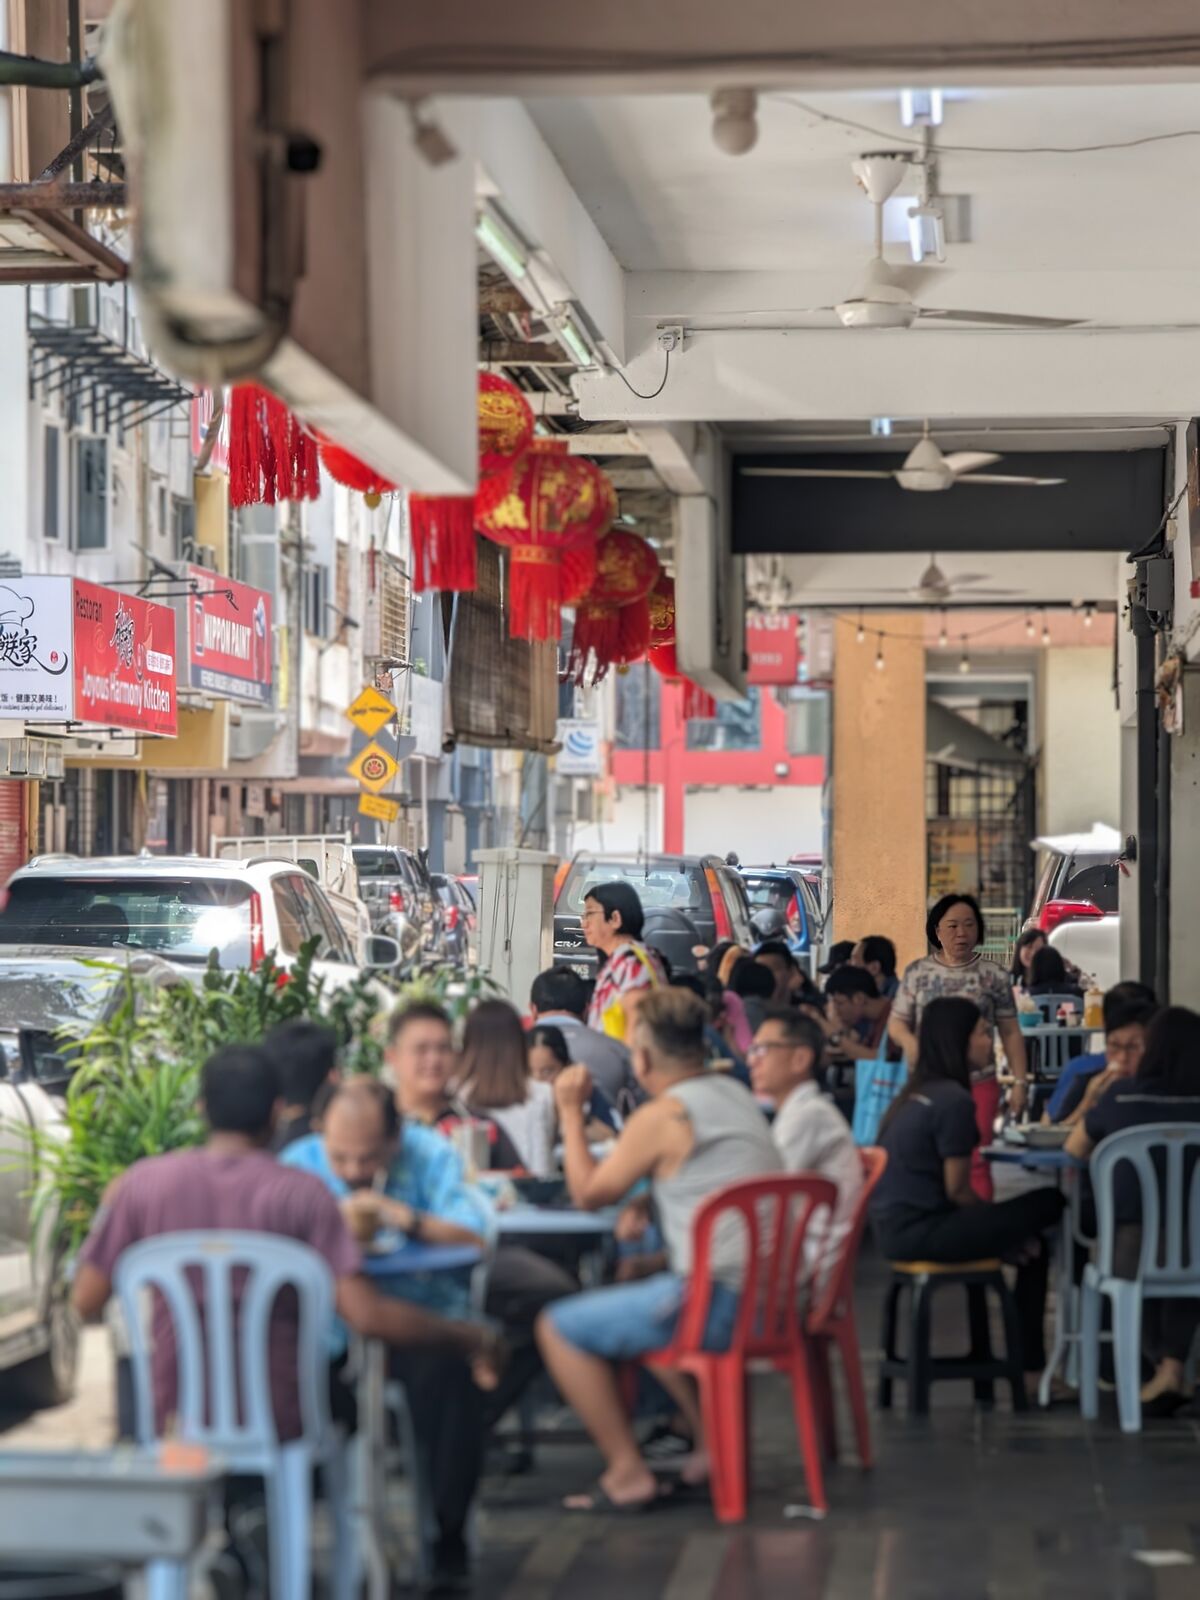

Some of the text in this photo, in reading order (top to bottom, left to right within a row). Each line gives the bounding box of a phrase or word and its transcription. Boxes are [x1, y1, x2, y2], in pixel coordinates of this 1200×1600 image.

[75, 589, 102, 622] Restoran
[204, 612, 251, 660] NIPPON PAINT
[82, 664, 110, 707] Joyous
[110, 671, 143, 715] Harmony
[143, 678, 171, 713] Kitchen
[554, 940, 582, 948] CR-V
